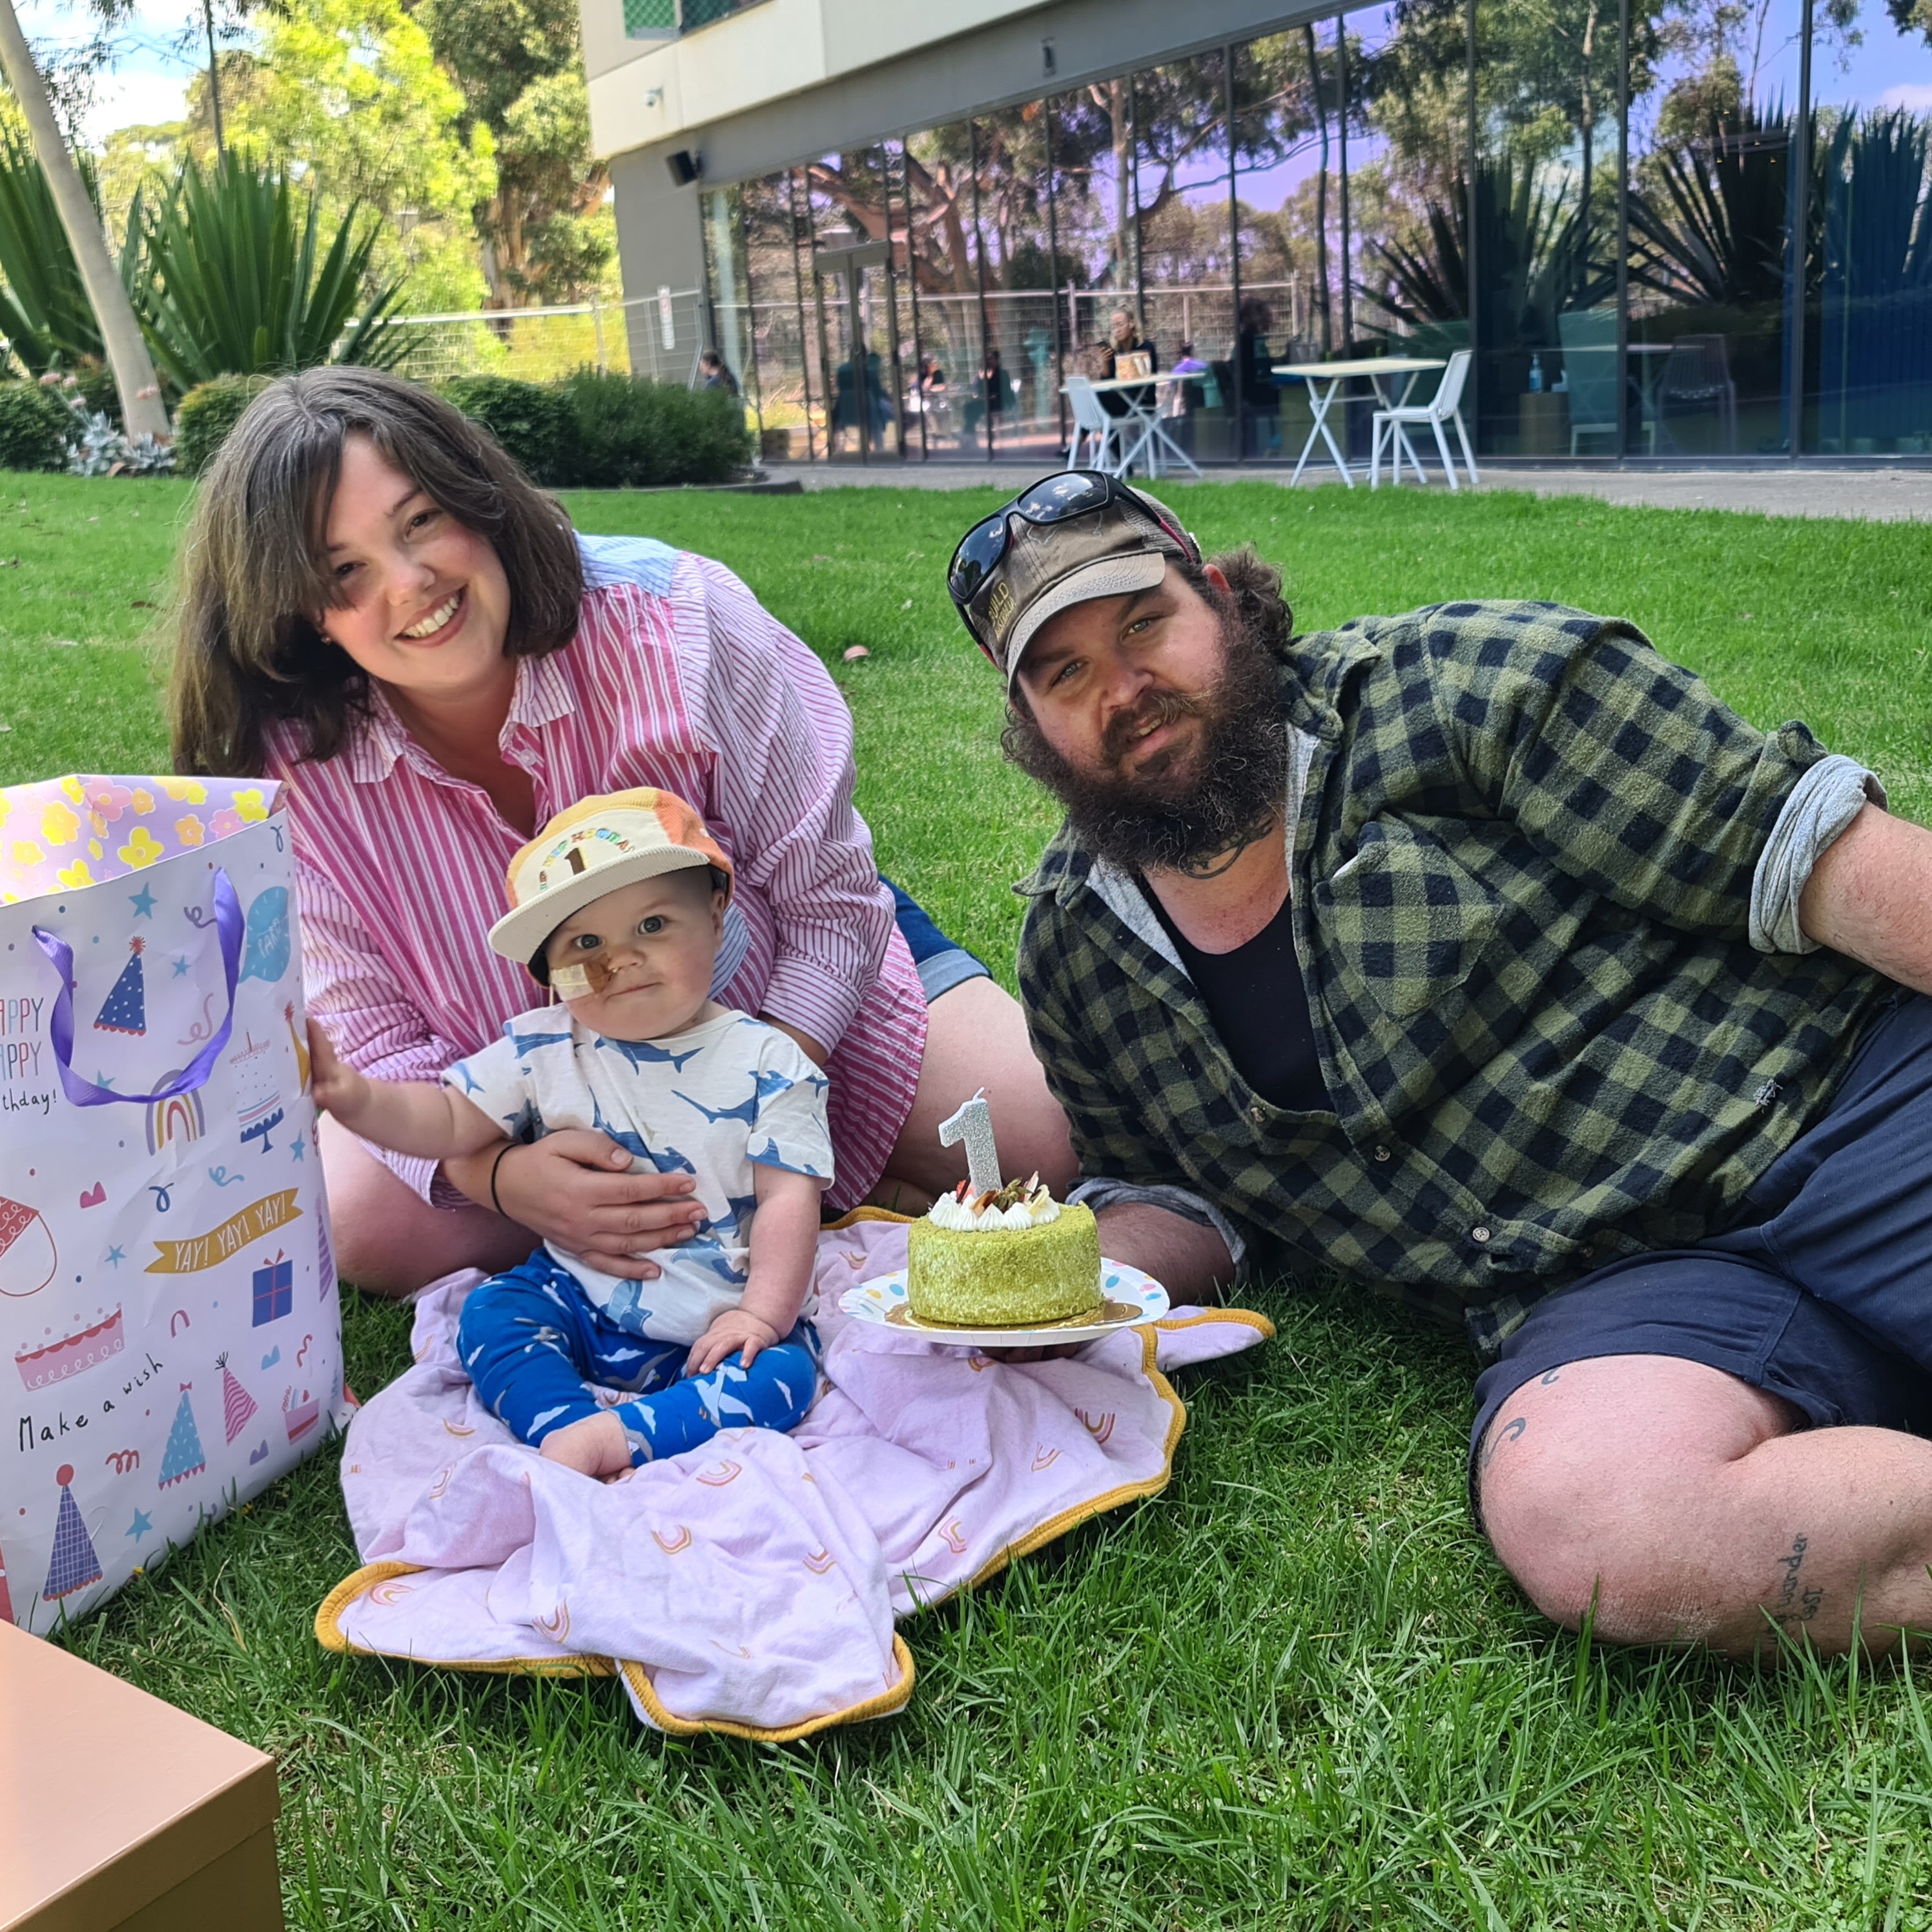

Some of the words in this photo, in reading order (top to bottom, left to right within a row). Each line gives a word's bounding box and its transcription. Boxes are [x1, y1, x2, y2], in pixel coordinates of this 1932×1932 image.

[564, 847, 588, 876] 1
[938, 1097, 1003, 1199] 1
[175, 1237, 209, 1272] YAY!
[216, 1215, 251, 1256] YAY!
[255, 1193, 286, 1231] YAY!
[20, 1412, 88, 1452] Make
[103, 1400, 115, 1412] a
[123, 1353, 163, 1394] wish
